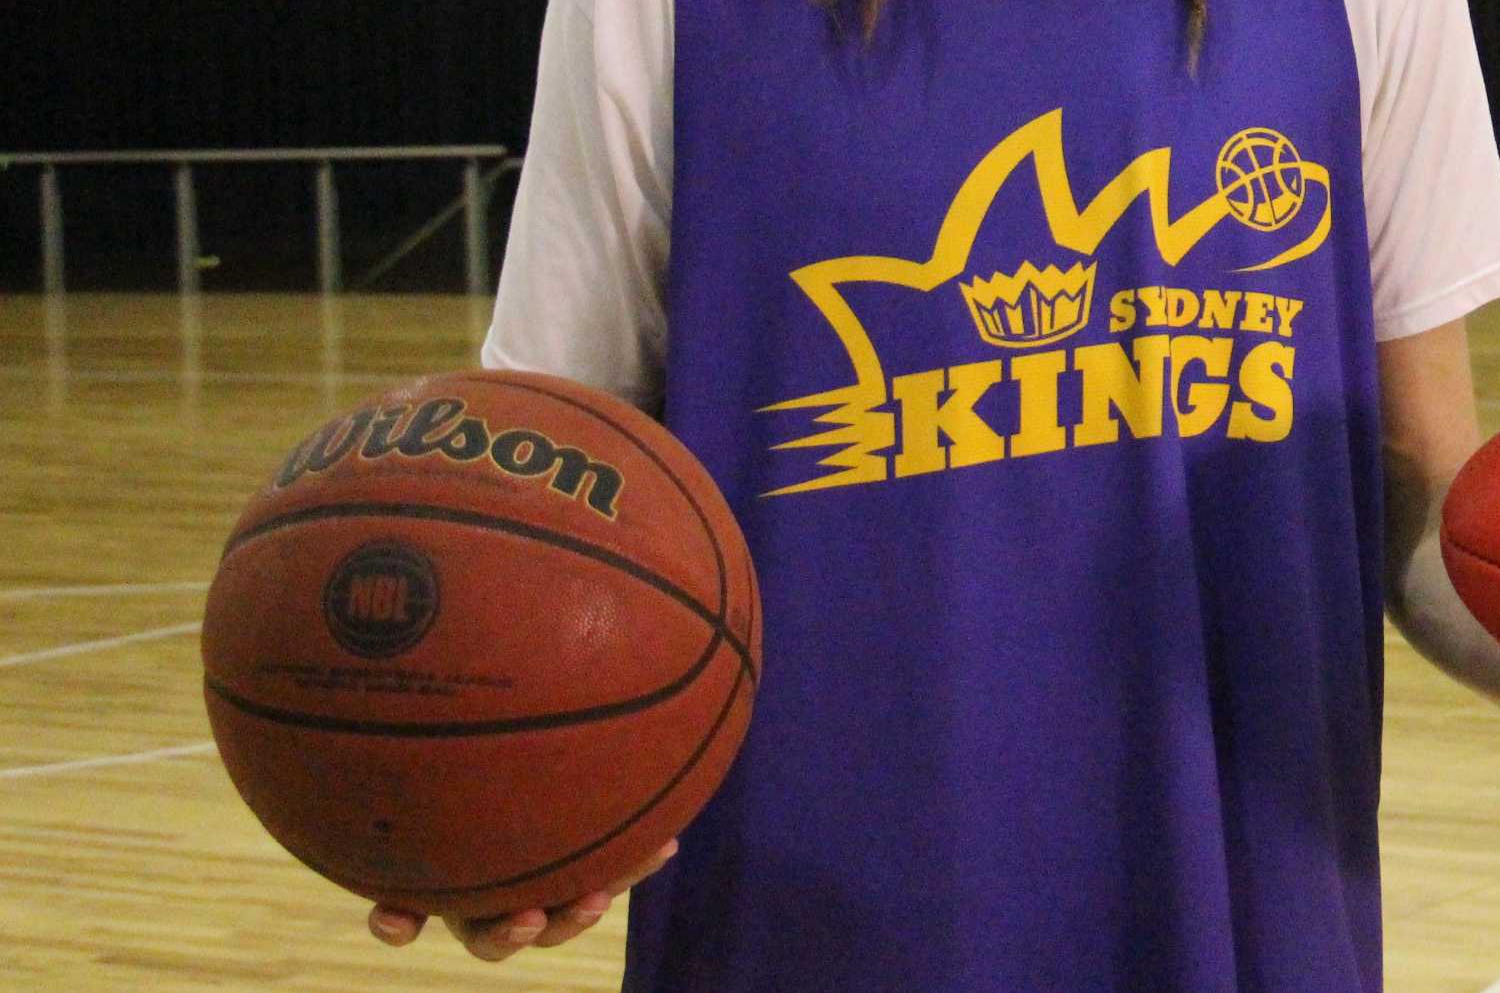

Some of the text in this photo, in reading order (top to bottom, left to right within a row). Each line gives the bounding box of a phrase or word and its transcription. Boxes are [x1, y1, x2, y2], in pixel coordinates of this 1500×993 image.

[1109, 285, 1303, 336] SYDNEY
[270, 396, 626, 523] Wilson
[893, 334, 1296, 478] KINGS
